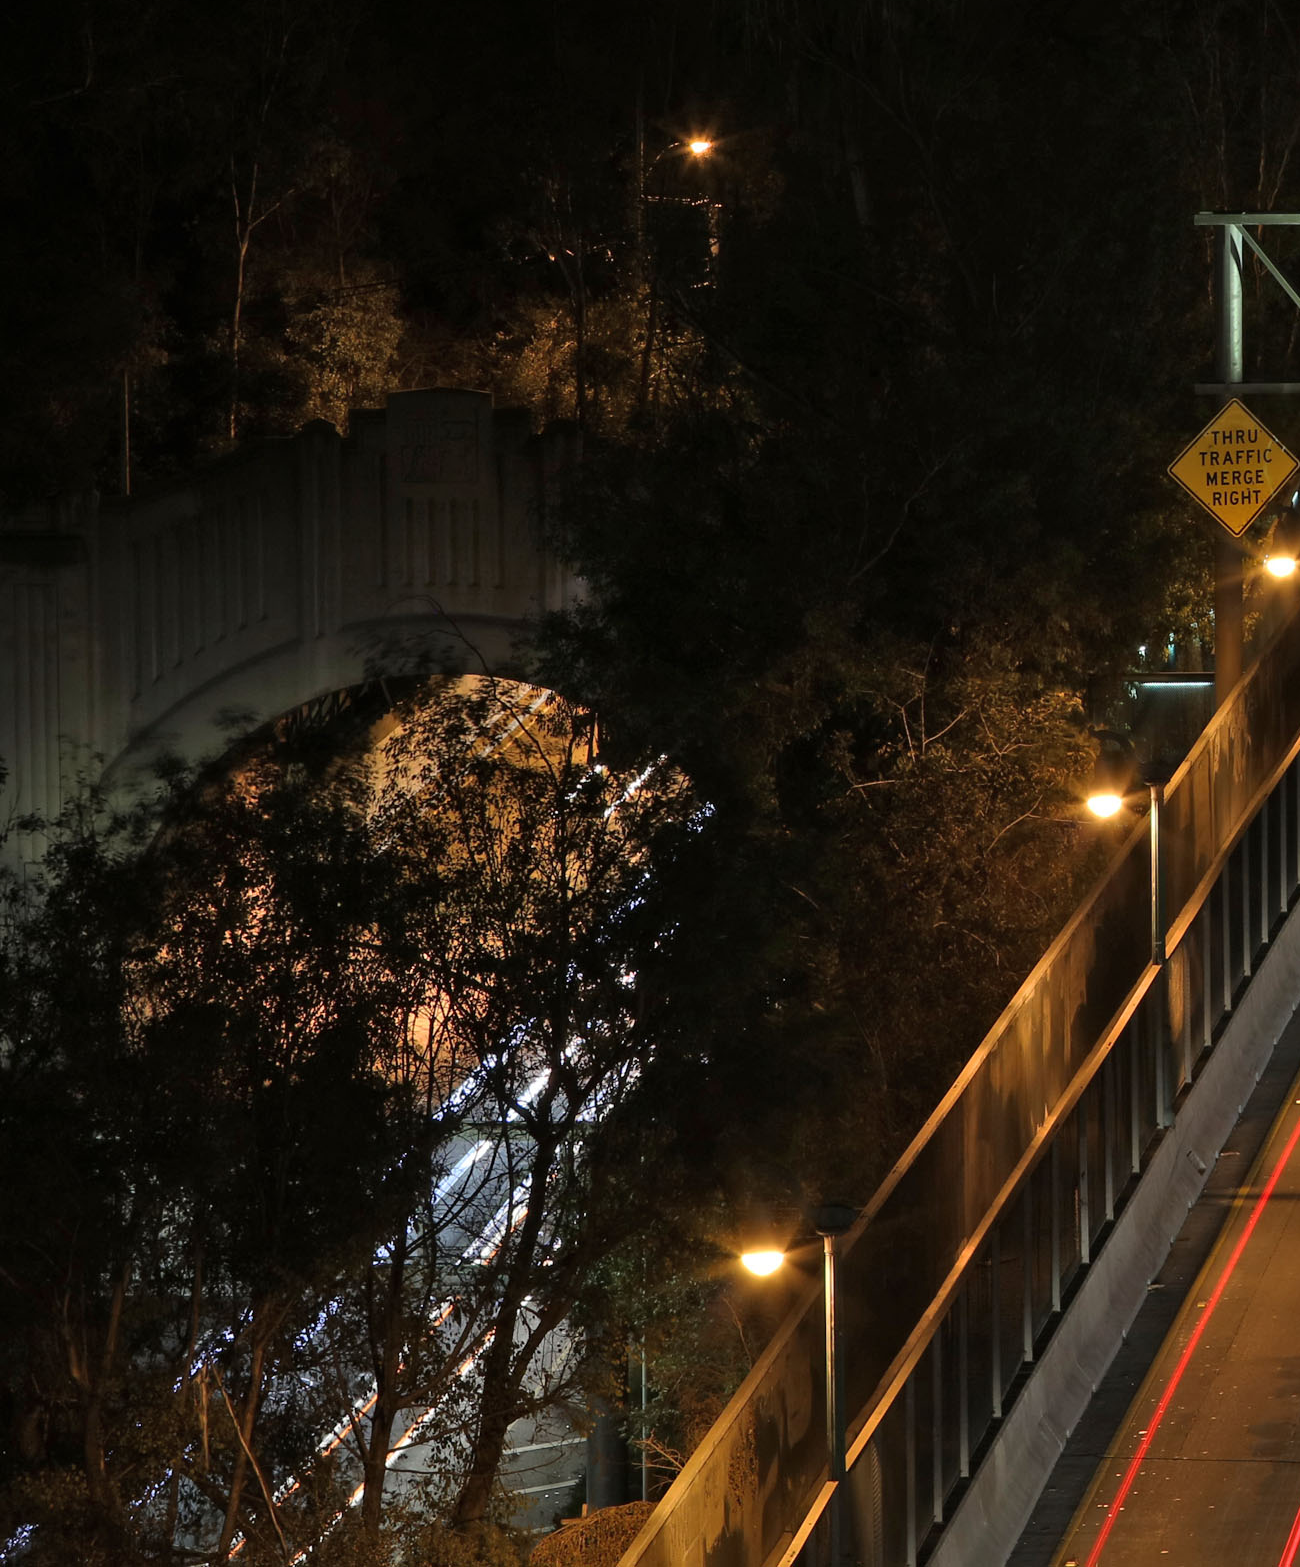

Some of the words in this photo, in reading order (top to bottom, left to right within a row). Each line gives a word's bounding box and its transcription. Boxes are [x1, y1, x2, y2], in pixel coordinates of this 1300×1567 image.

[1211, 429, 1258, 445] THRU
[1200, 449, 1272, 466] TRAFFIC
[1206, 470, 1264, 486] MERGE
[1212, 490, 1261, 506] RIGHT
